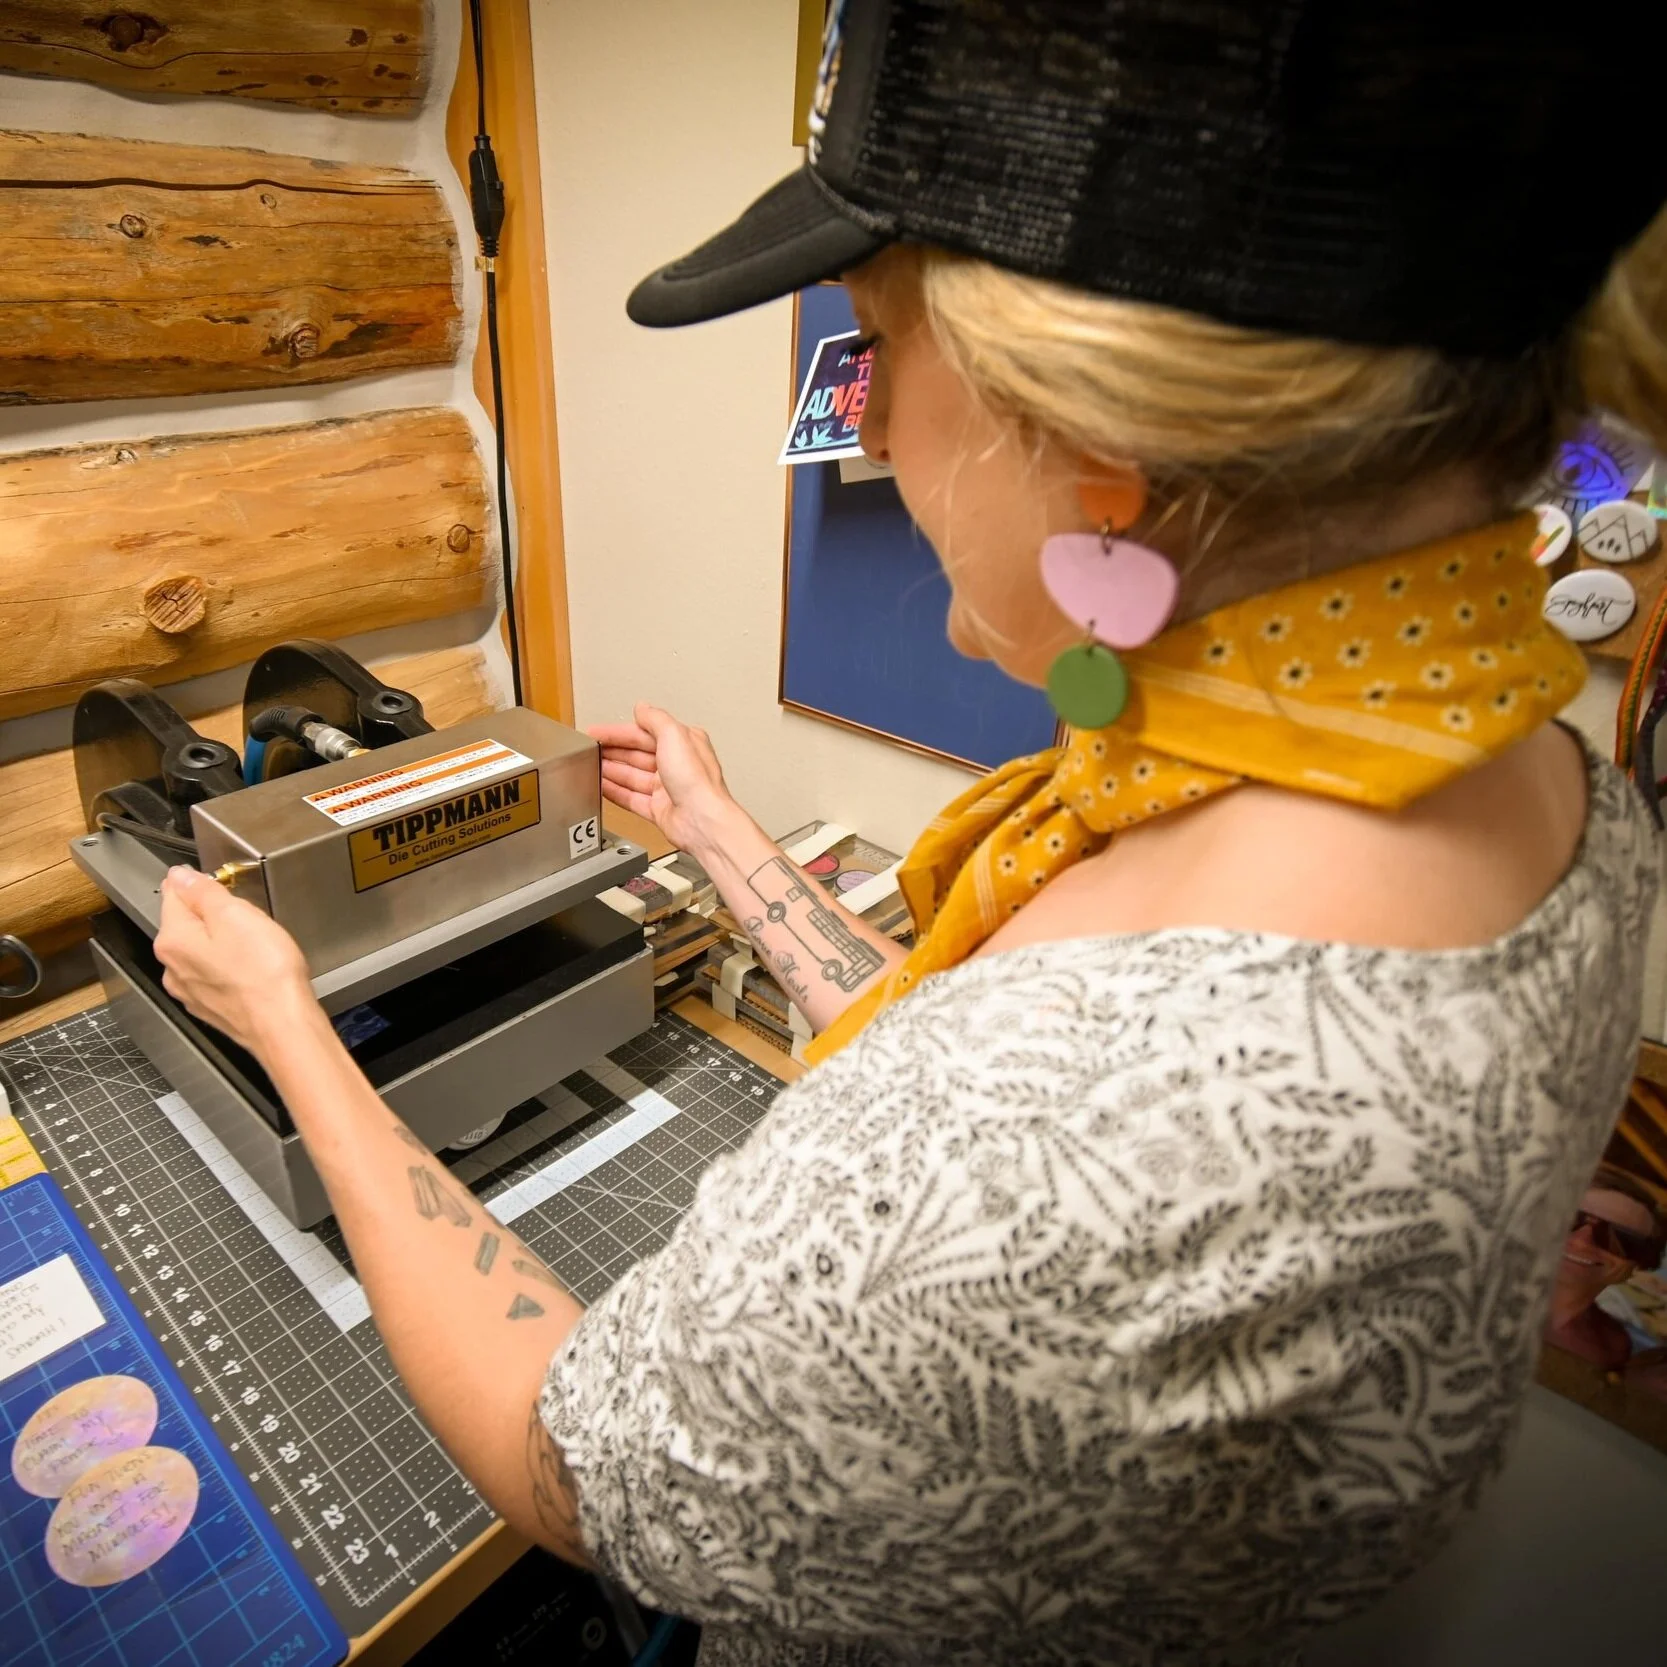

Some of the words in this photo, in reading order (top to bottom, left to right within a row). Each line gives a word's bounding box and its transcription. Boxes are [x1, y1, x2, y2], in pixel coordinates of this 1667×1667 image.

[800, 380, 870, 421] ADVE
[325, 770, 404, 797] WARNING
[343, 780, 423, 809] WARNING
[373, 779, 521, 852] TIPPMANN
[388, 851, 409, 866] Die
[411, 833, 456, 857] Cutting
[458, 812, 511, 840] Solutions
[573, 819, 596, 844] CE
[667, 1031, 680, 1041] 15
[686, 1044, 700, 1054] 16
[706, 1057, 722, 1067] 17
[23, 1072, 36, 1080] 2
[728, 1071, 743, 1082] 18
[33, 1087, 46, 1095] 3
[750, 1085, 765, 1096] 19
[54, 1118, 69, 1126] 5
[66, 1133, 80, 1143] 6
[78, 1150, 93, 1159] 7
[89, 1168, 104, 1177] 8
[102, 1186, 116, 1196] 9
[114, 1203, 131, 1217] 10
[128, 1223, 145, 1238] 11
[142, 1244, 159, 1259] 12
[156, 1265, 175, 1280] 13
[171, 1287, 191, 1303] 14
[188, 1310, 207, 1327] 15
[204, 1334, 224, 1352] 16
[222, 1360, 242, 1376] 17
[240, 1386, 261, 1405] 18
[259, 1414, 280, 1433] 19
[277, 1441, 301, 1464] 20
[299, 1472, 323, 1496] 21
[321, 1503, 346, 1531] 22
[423, 1510, 441, 1529] 2
[344, 1537, 370, 1565] 23
[384, 1543, 399, 1558] 1
